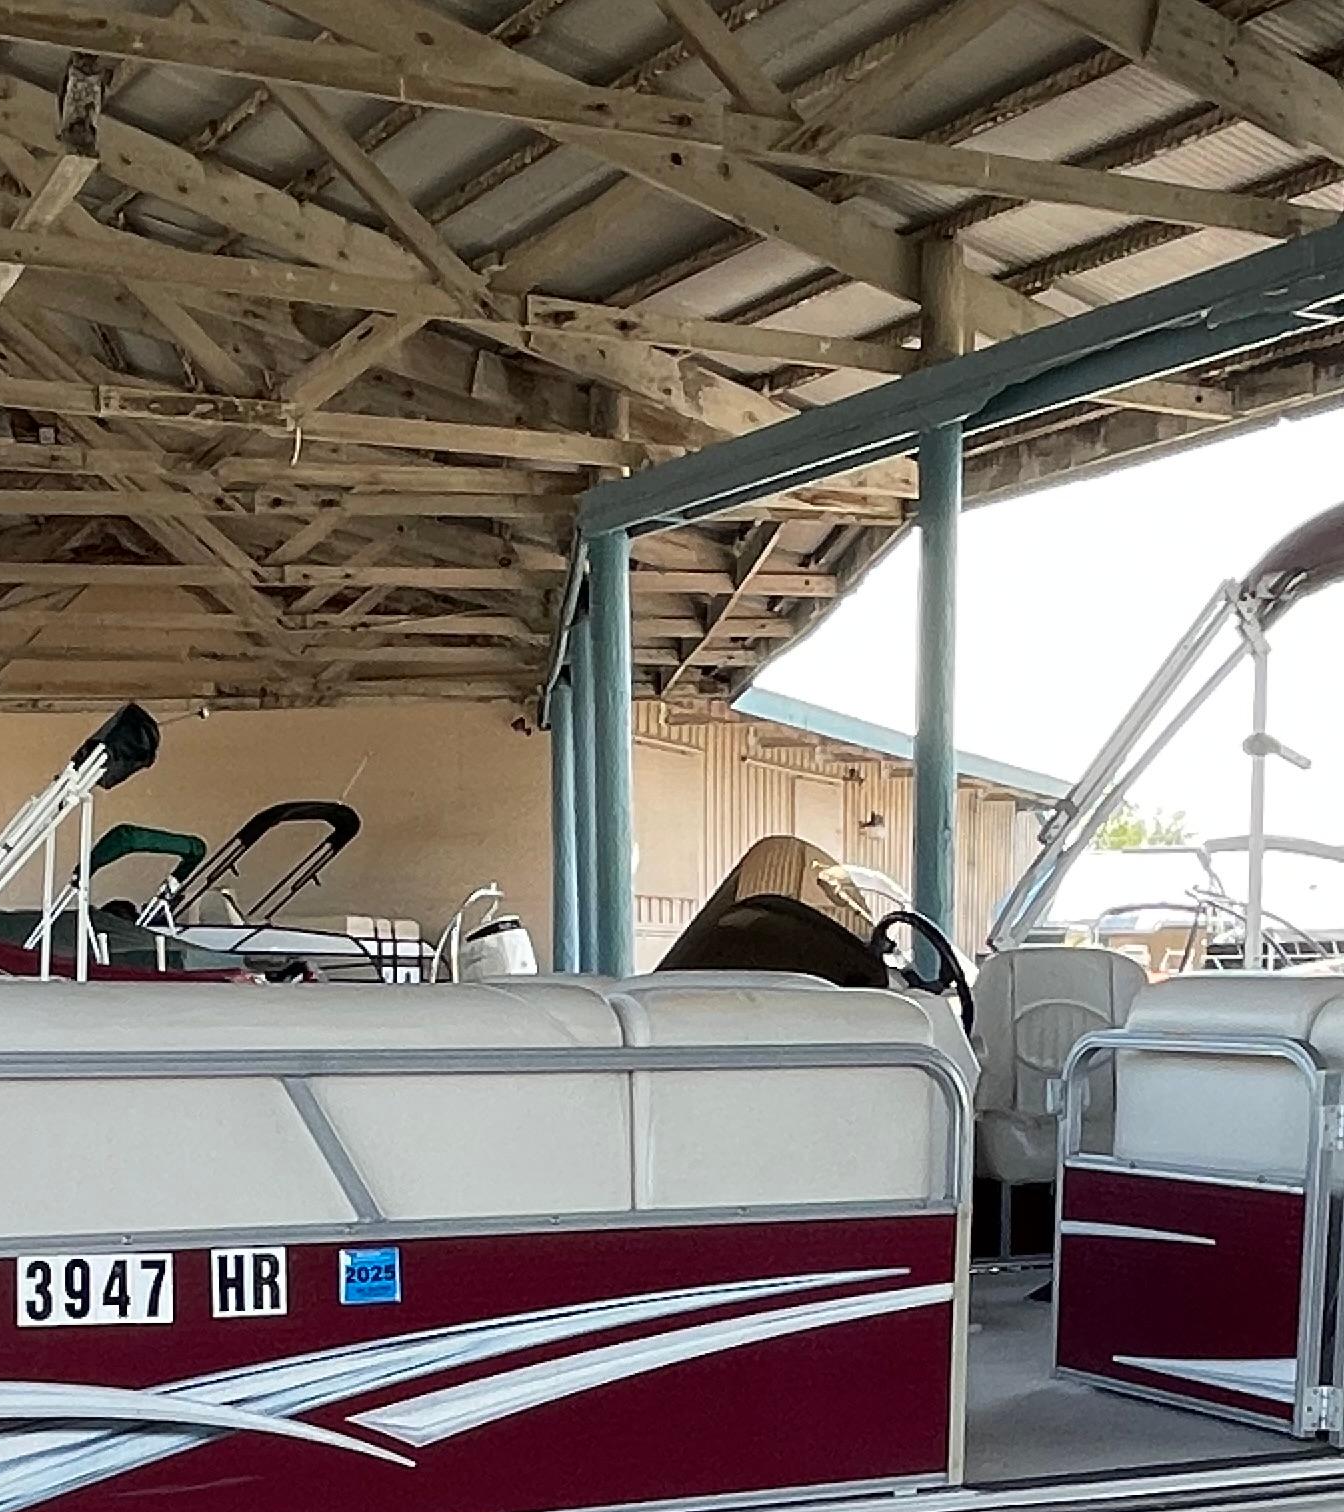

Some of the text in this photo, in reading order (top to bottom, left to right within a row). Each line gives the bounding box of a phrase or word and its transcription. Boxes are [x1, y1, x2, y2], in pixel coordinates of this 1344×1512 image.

[25, 1258, 167, 1321] 3947
[219, 1253, 282, 1312] HR
[345, 1264, 396, 1284] 2025
